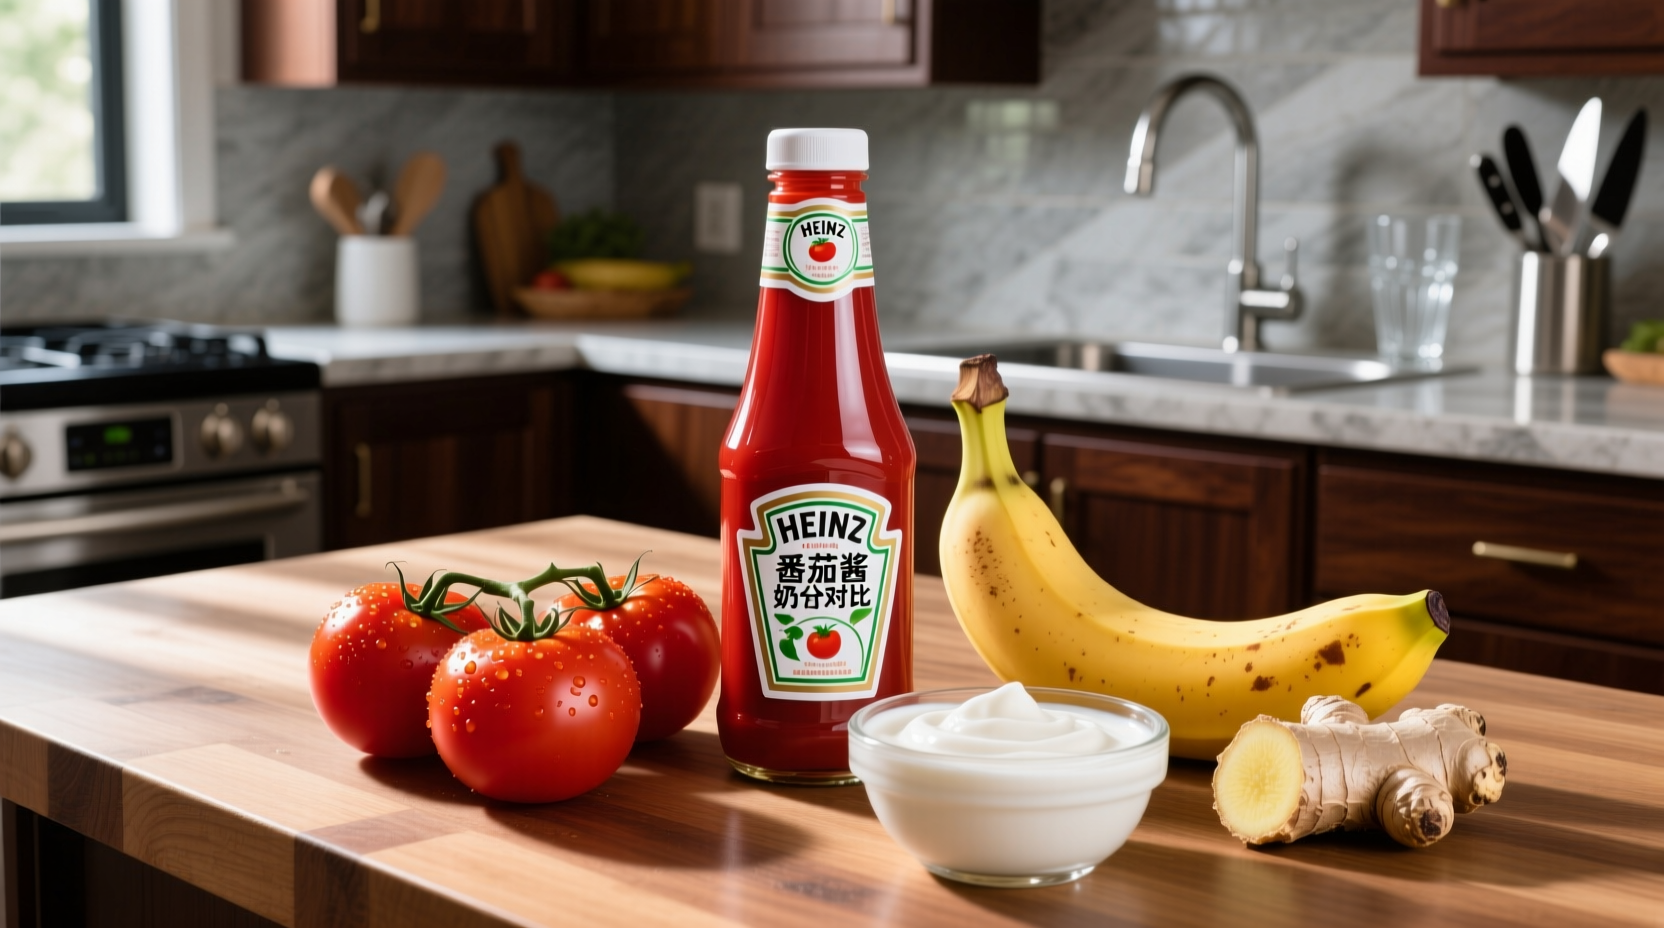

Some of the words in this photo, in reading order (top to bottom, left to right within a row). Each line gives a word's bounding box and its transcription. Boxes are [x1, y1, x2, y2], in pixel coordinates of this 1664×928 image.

[800, 220, 846, 239] HEINZ
[776, 511, 867, 544] HEINZ
[775, 552, 868, 584] 番茄酱
